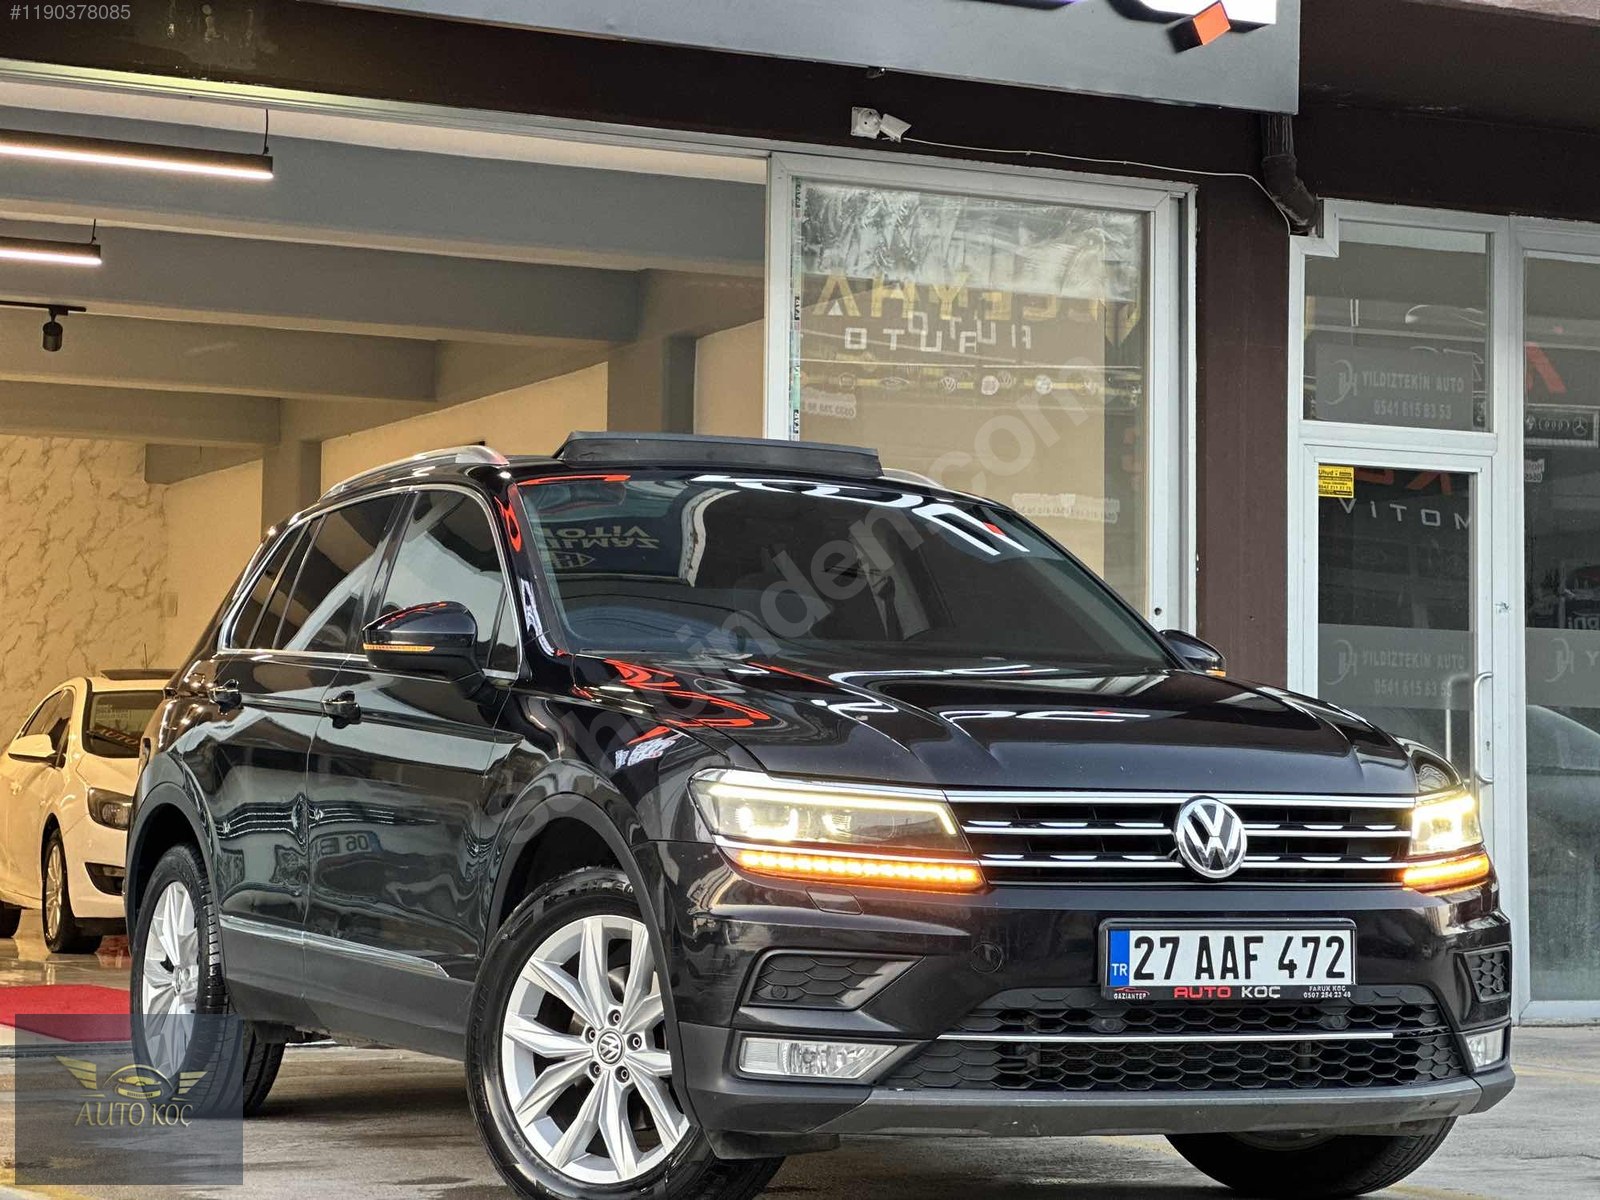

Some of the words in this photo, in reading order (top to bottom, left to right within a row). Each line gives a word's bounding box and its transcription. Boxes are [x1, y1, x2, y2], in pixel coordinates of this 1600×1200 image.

[1436, 376, 1465, 393] AUTO
[1111, 963, 1128, 976] TR
[1133, 935, 1180, 981] 27
[1194, 935, 1263, 980] AAF
[1277, 935, 1346, 979] 472
[1173, 986, 1231, 998] AUTO
[1241, 986, 1281, 999] KOÇ
